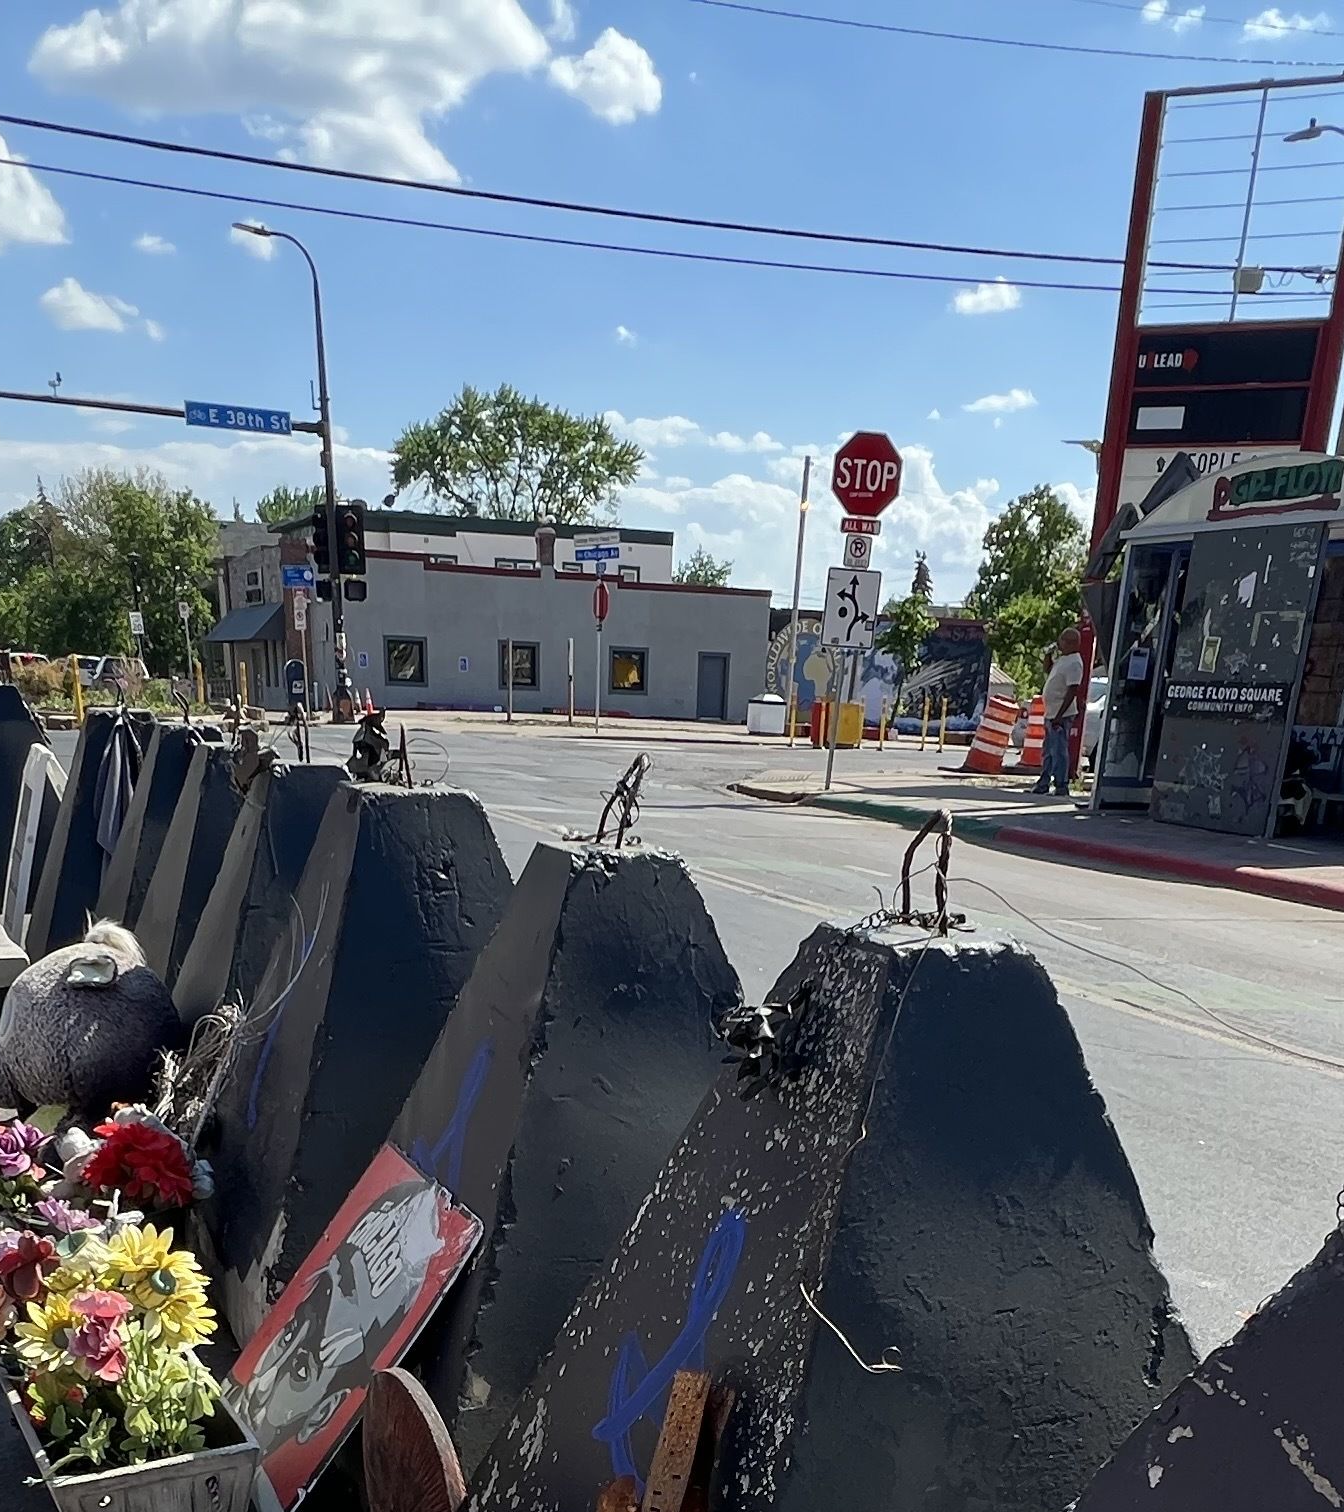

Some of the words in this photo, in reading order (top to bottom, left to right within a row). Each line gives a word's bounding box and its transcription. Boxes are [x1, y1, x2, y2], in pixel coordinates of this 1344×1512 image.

[208, 408, 220, 424] E
[226, 410, 265, 429] 38th
[271, 415, 288, 431] St
[836, 457, 898, 492] STOP
[843, 521, 857, 531] ALL
[1168, 685, 1204, 699] GEORGE
[1206, 686, 1238, 700] FLOYD
[1240, 688, 1283, 702] SQUARE
[1187, 701, 1233, 712] COMMUNITY
